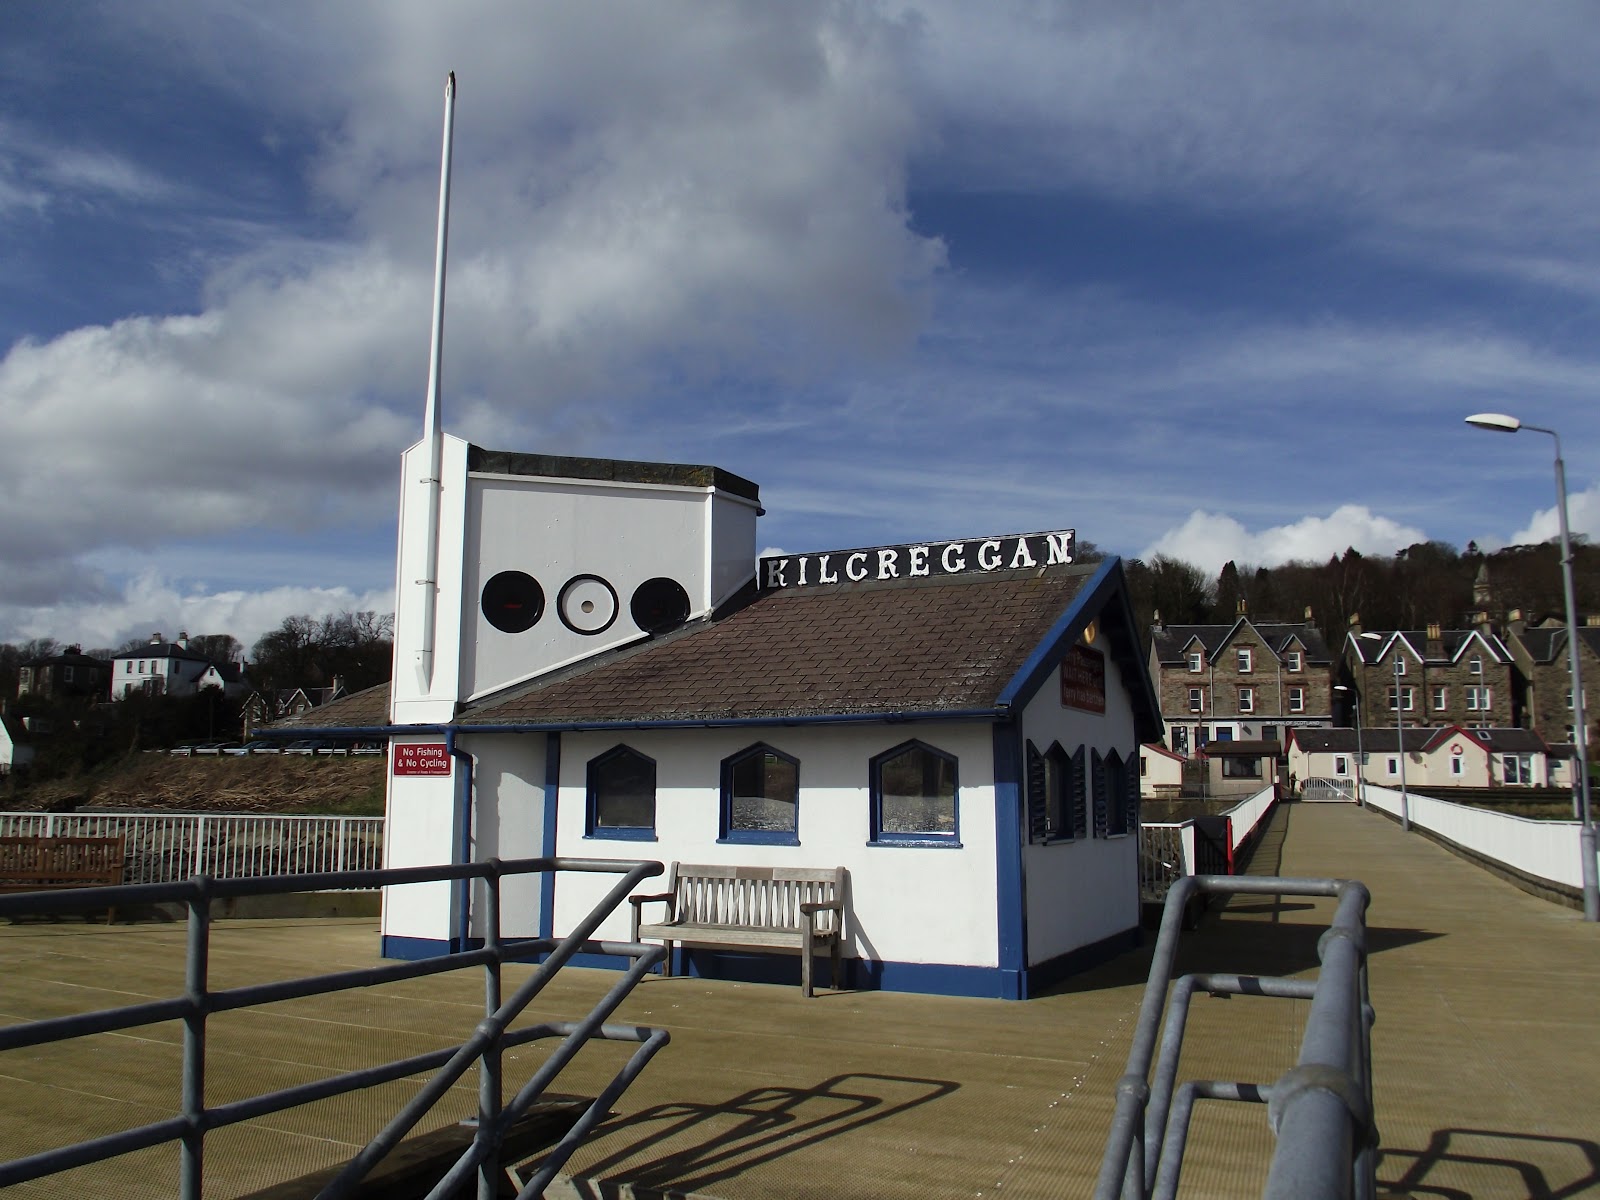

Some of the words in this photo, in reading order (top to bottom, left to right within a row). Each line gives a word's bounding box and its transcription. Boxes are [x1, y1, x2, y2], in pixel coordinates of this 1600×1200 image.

[766, 533, 1072, 587] KILCREGGAN
[403, 748, 414, 756] No
[417, 747, 443, 757] Fishing
[397, 759, 403, 767] &
[406, 759, 417, 767] No
[420, 758, 447, 768] Cycling
